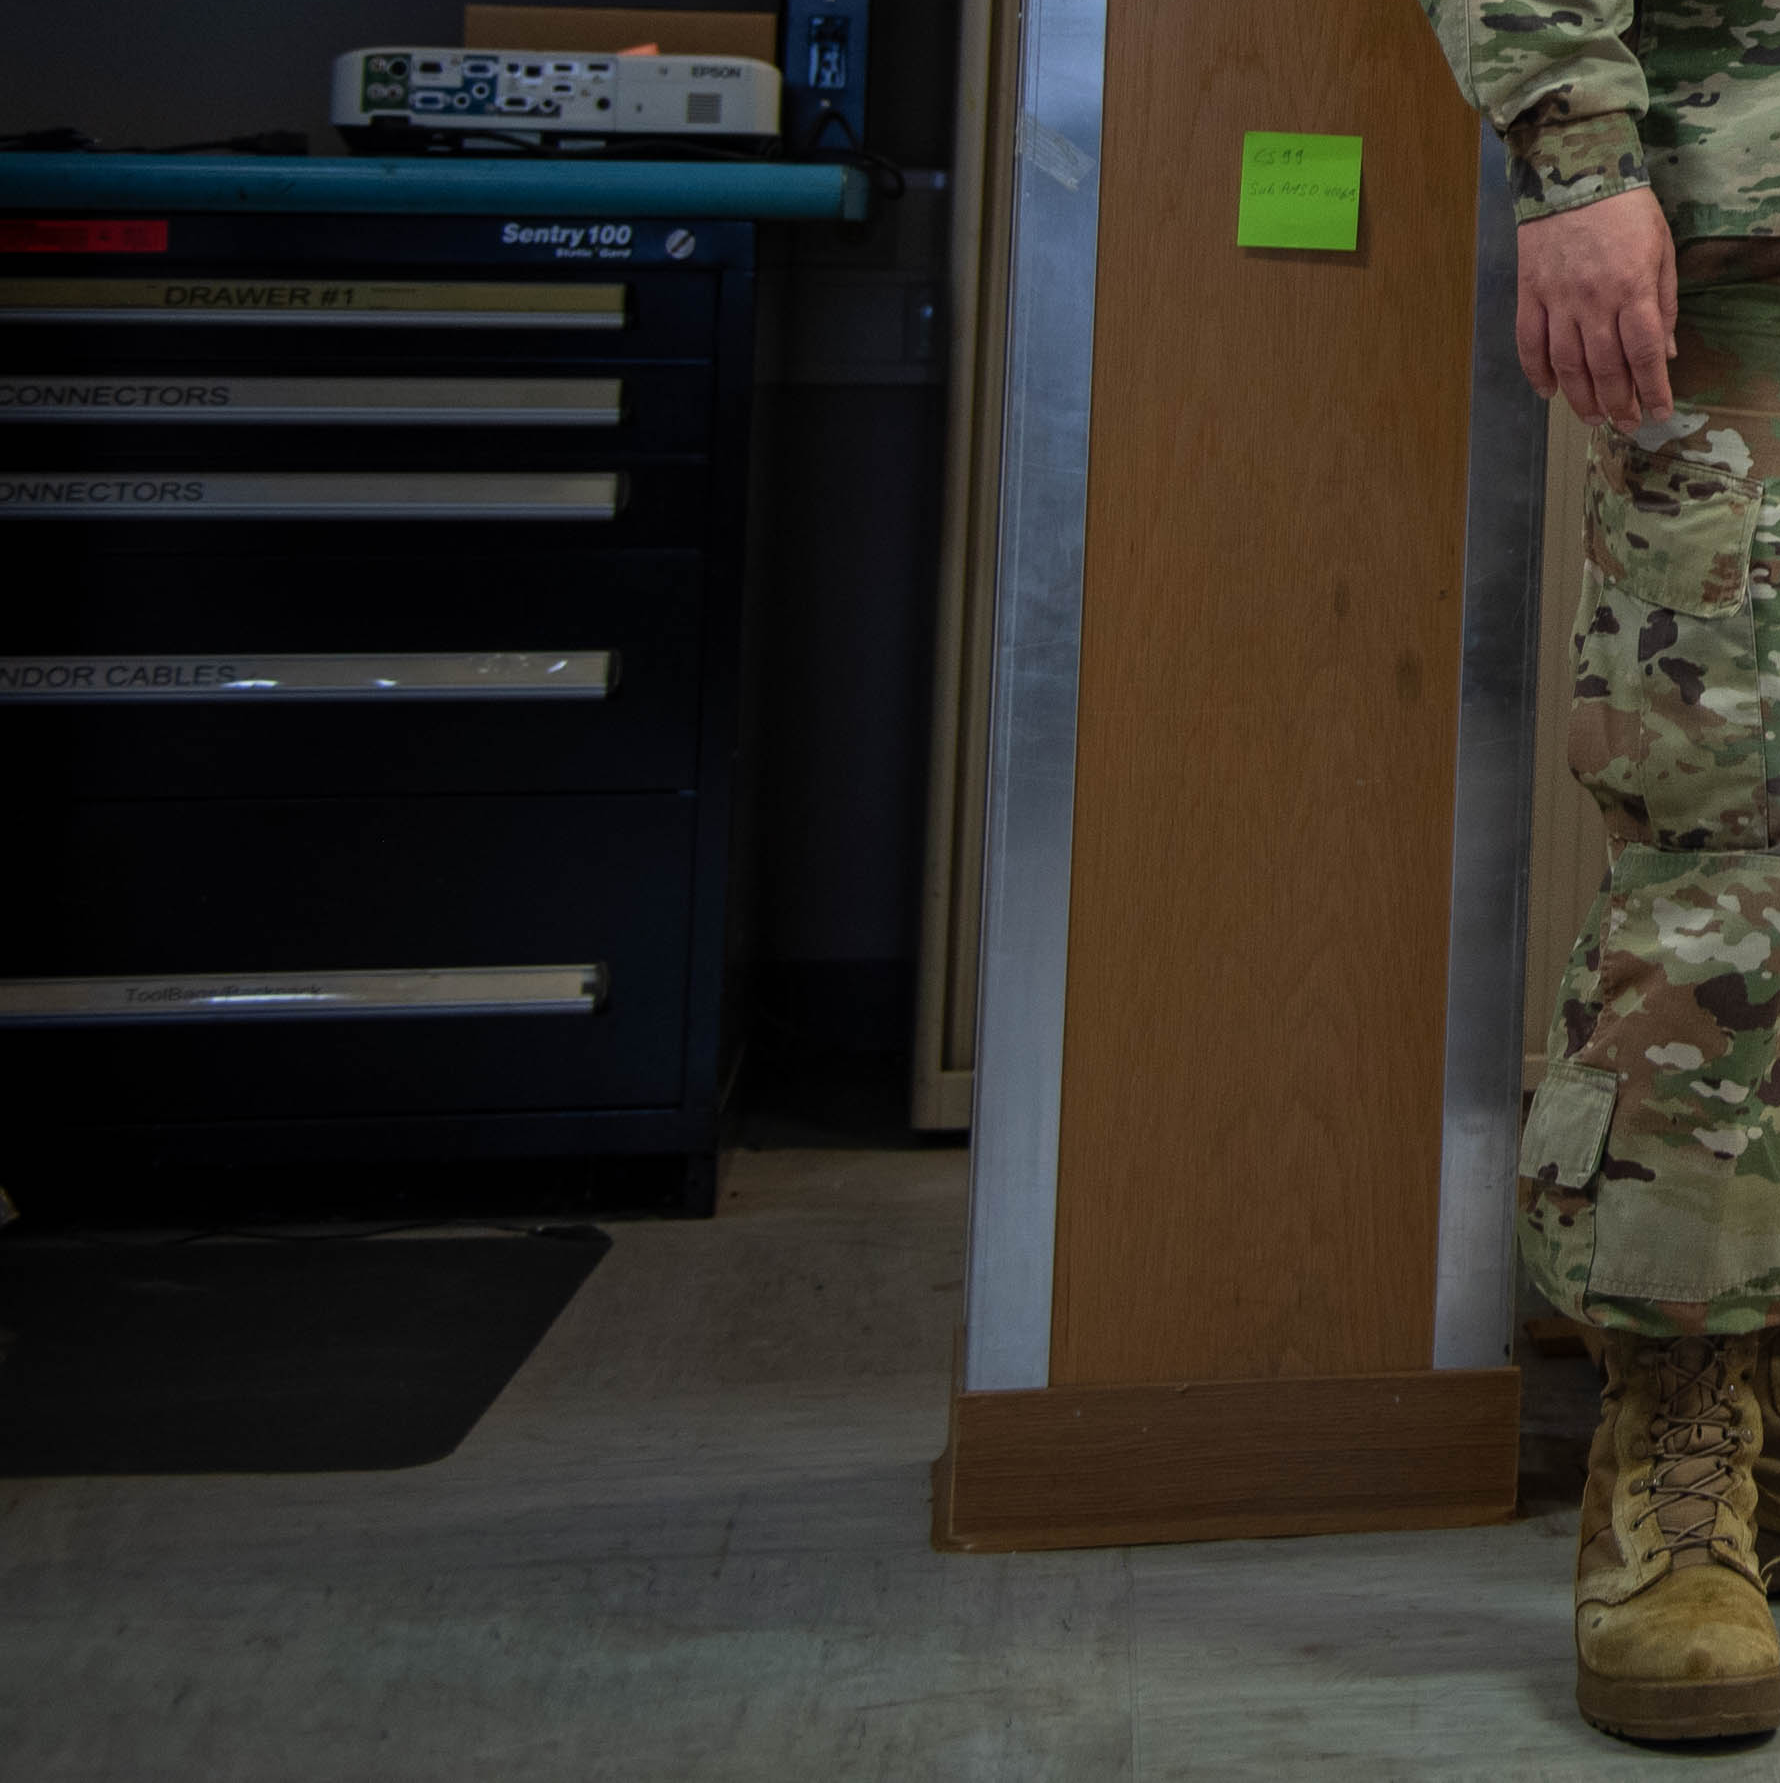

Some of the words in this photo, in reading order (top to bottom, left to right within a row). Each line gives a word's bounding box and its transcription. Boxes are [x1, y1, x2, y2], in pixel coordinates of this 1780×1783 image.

[692, 66, 741, 79] EPSON
[502, 221, 585, 248] Sentry
[589, 224, 632, 246] 100
[164, 286, 310, 307] DRAWER
[321, 286, 355, 307] #1
[0, 386, 230, 407] CONNECTORS
[106, 665, 237, 687] CABLES
